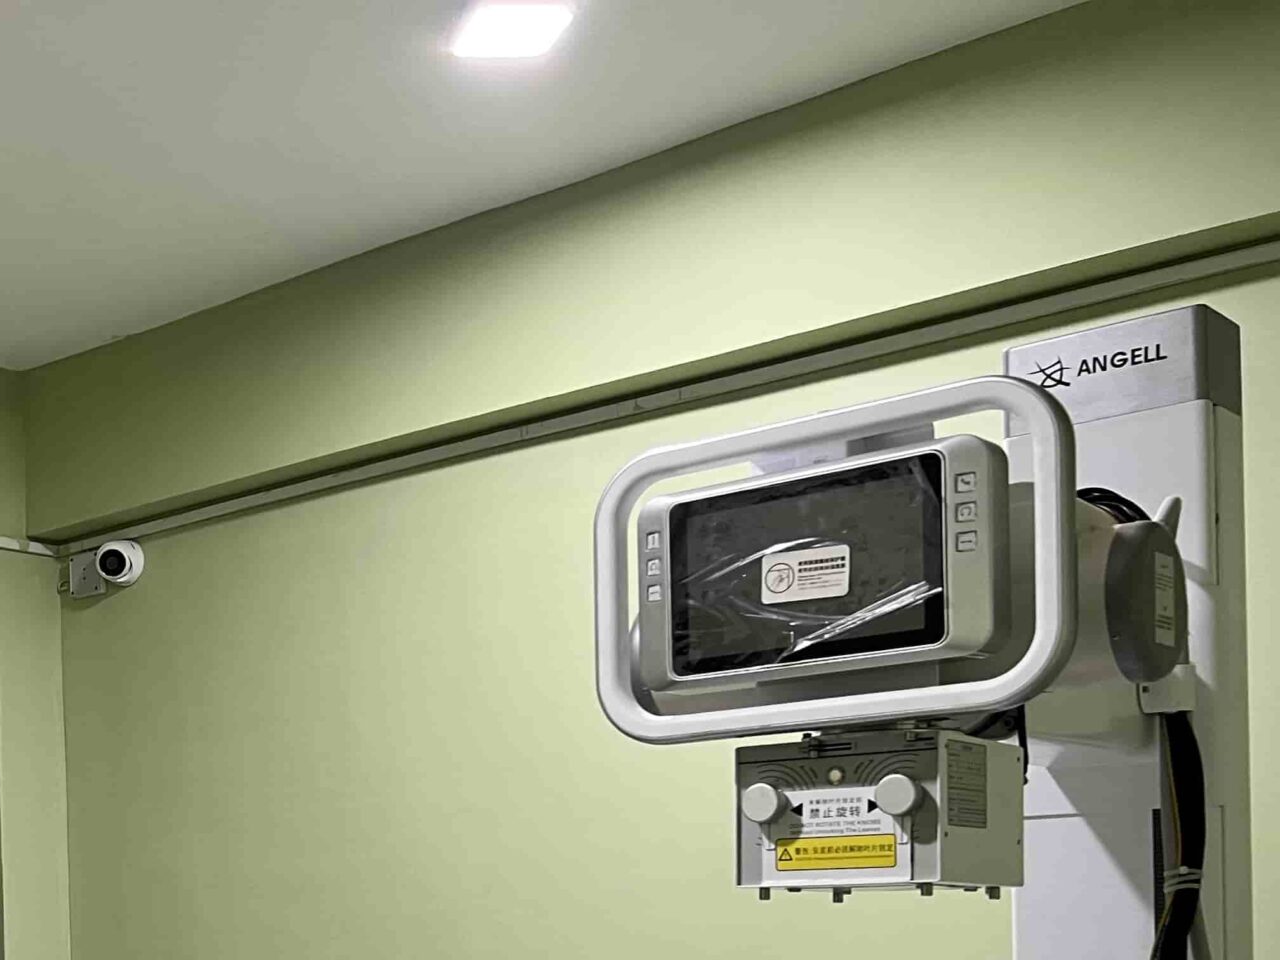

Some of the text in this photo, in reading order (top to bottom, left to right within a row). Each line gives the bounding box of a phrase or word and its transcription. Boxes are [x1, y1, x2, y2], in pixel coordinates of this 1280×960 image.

[1077, 343, 1167, 377] ANGELL
[809, 806, 861, 819] 禁止旋转
